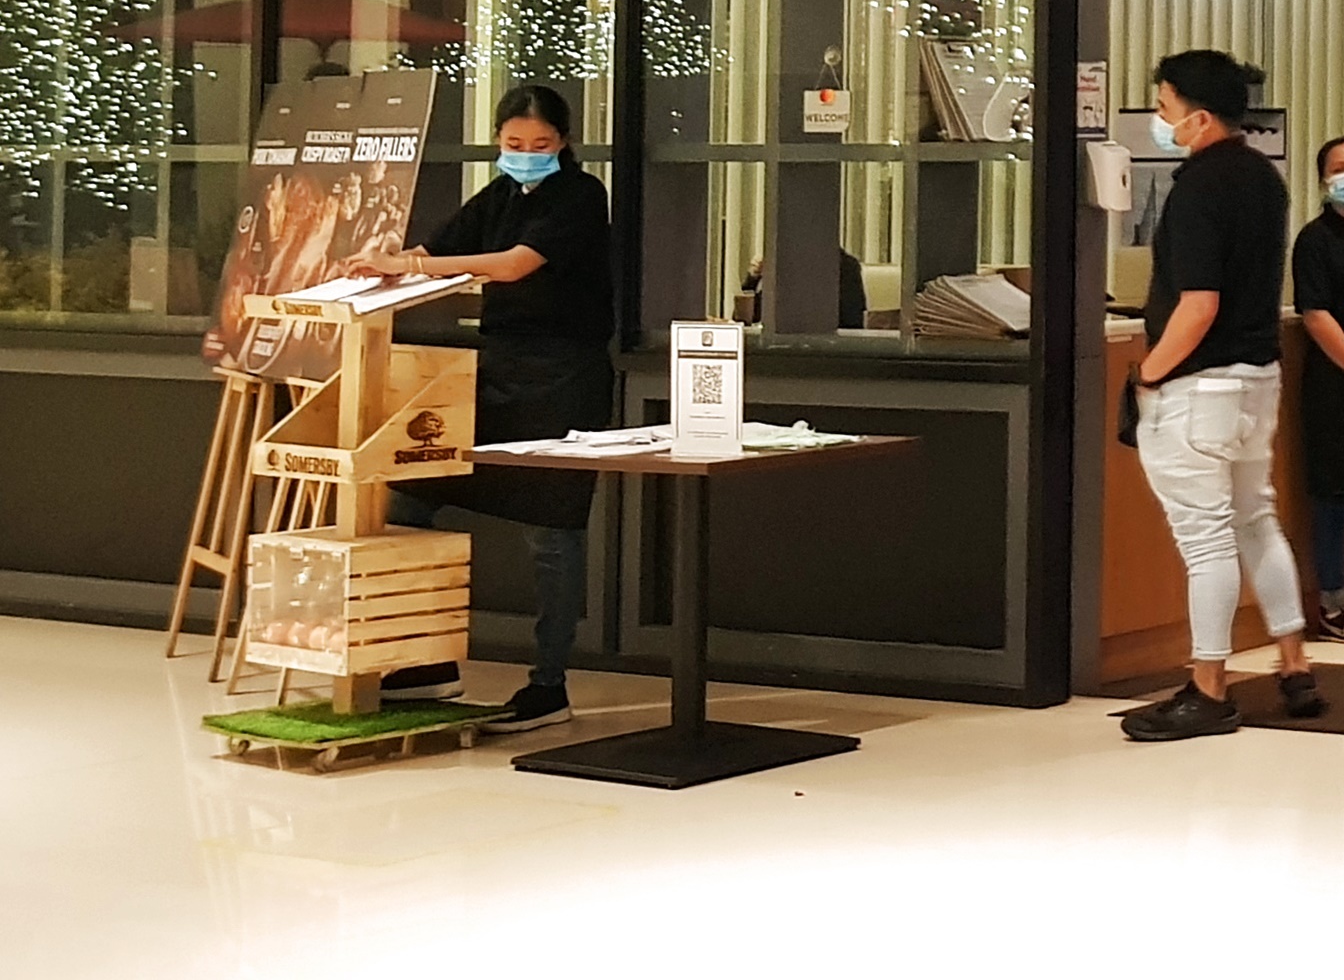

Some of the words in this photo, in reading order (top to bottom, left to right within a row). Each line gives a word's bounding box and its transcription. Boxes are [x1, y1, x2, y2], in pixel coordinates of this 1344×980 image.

[352, 136, 379, 162] ZERO
[378, 136, 418, 162] FILLERS
[285, 452, 340, 477] SOMERSBY
[394, 447, 458, 464] SOMERSBY
